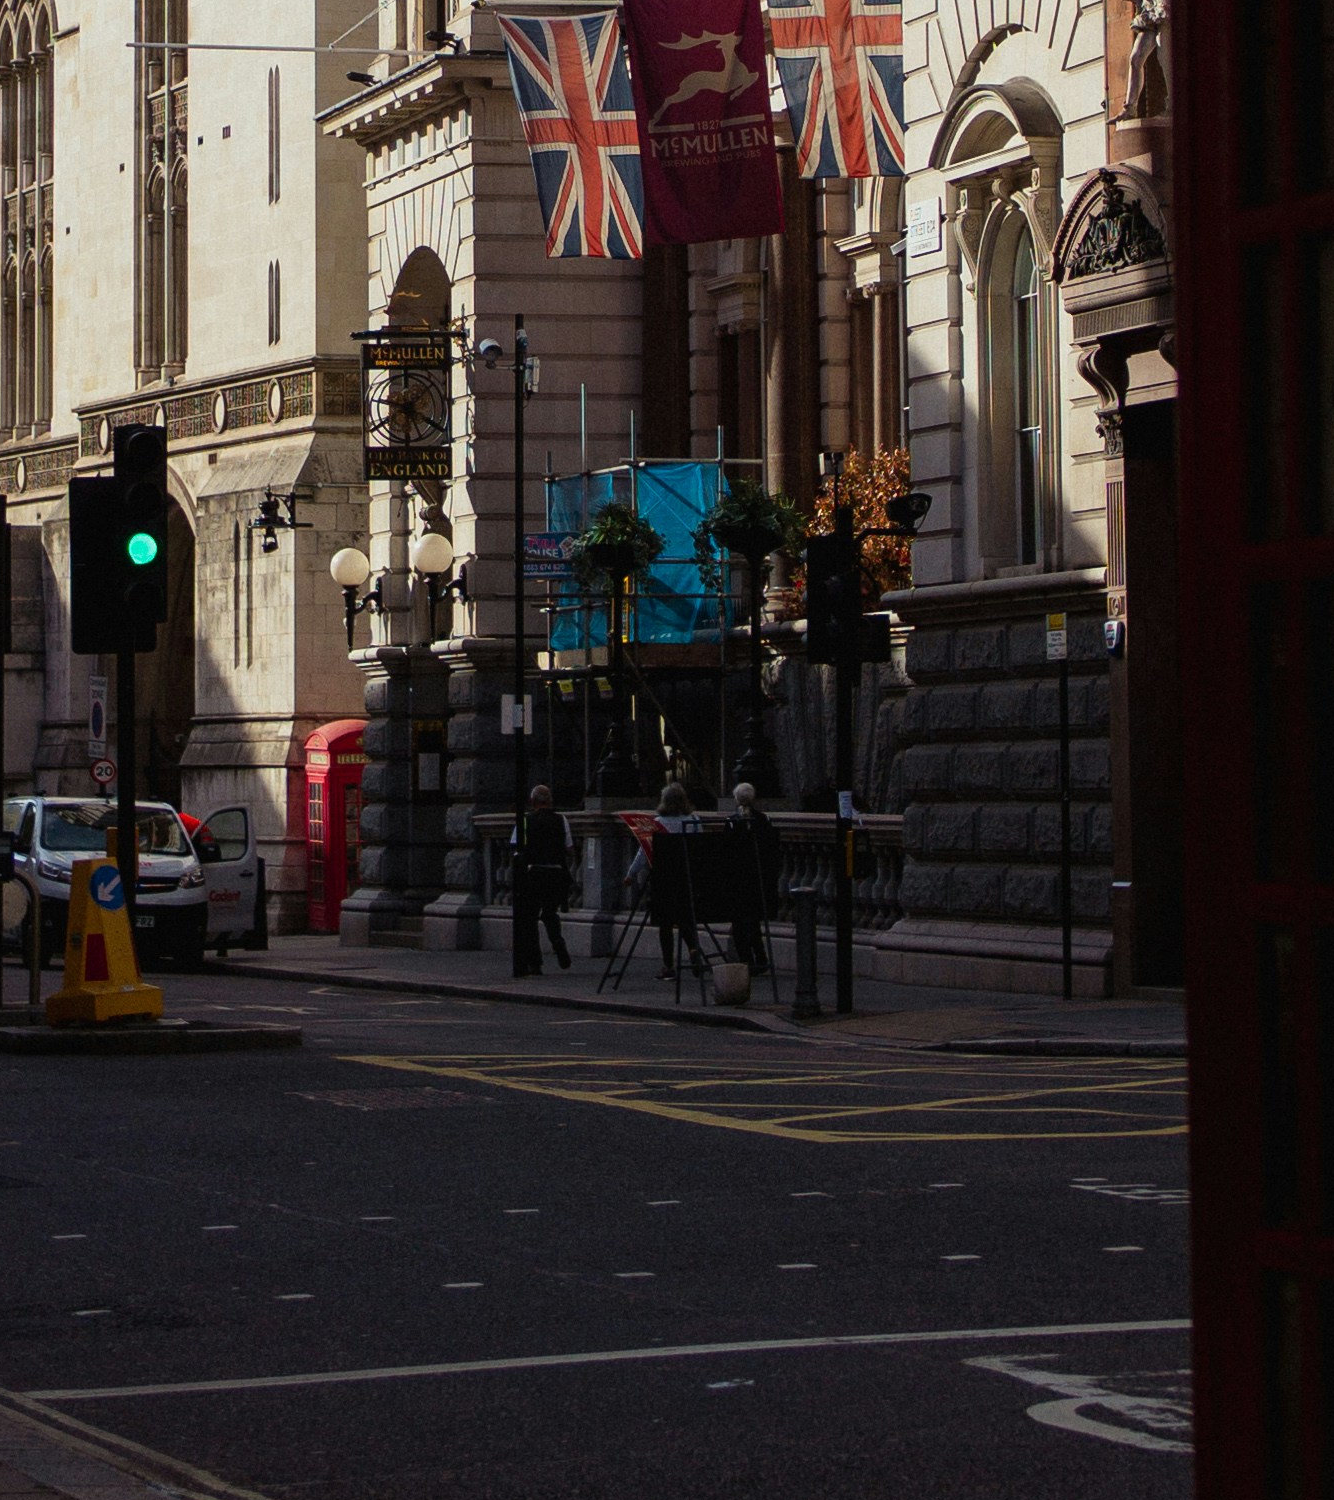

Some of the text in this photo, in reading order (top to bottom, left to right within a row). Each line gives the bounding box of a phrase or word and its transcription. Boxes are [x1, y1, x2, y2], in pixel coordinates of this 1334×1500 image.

[696, 120, 720, 131] 1827
[661, 149, 761, 168] BREWING AND PUBS
[369, 463, 449, 476] ENGLAND
[96, 766, 114, 776] 20
